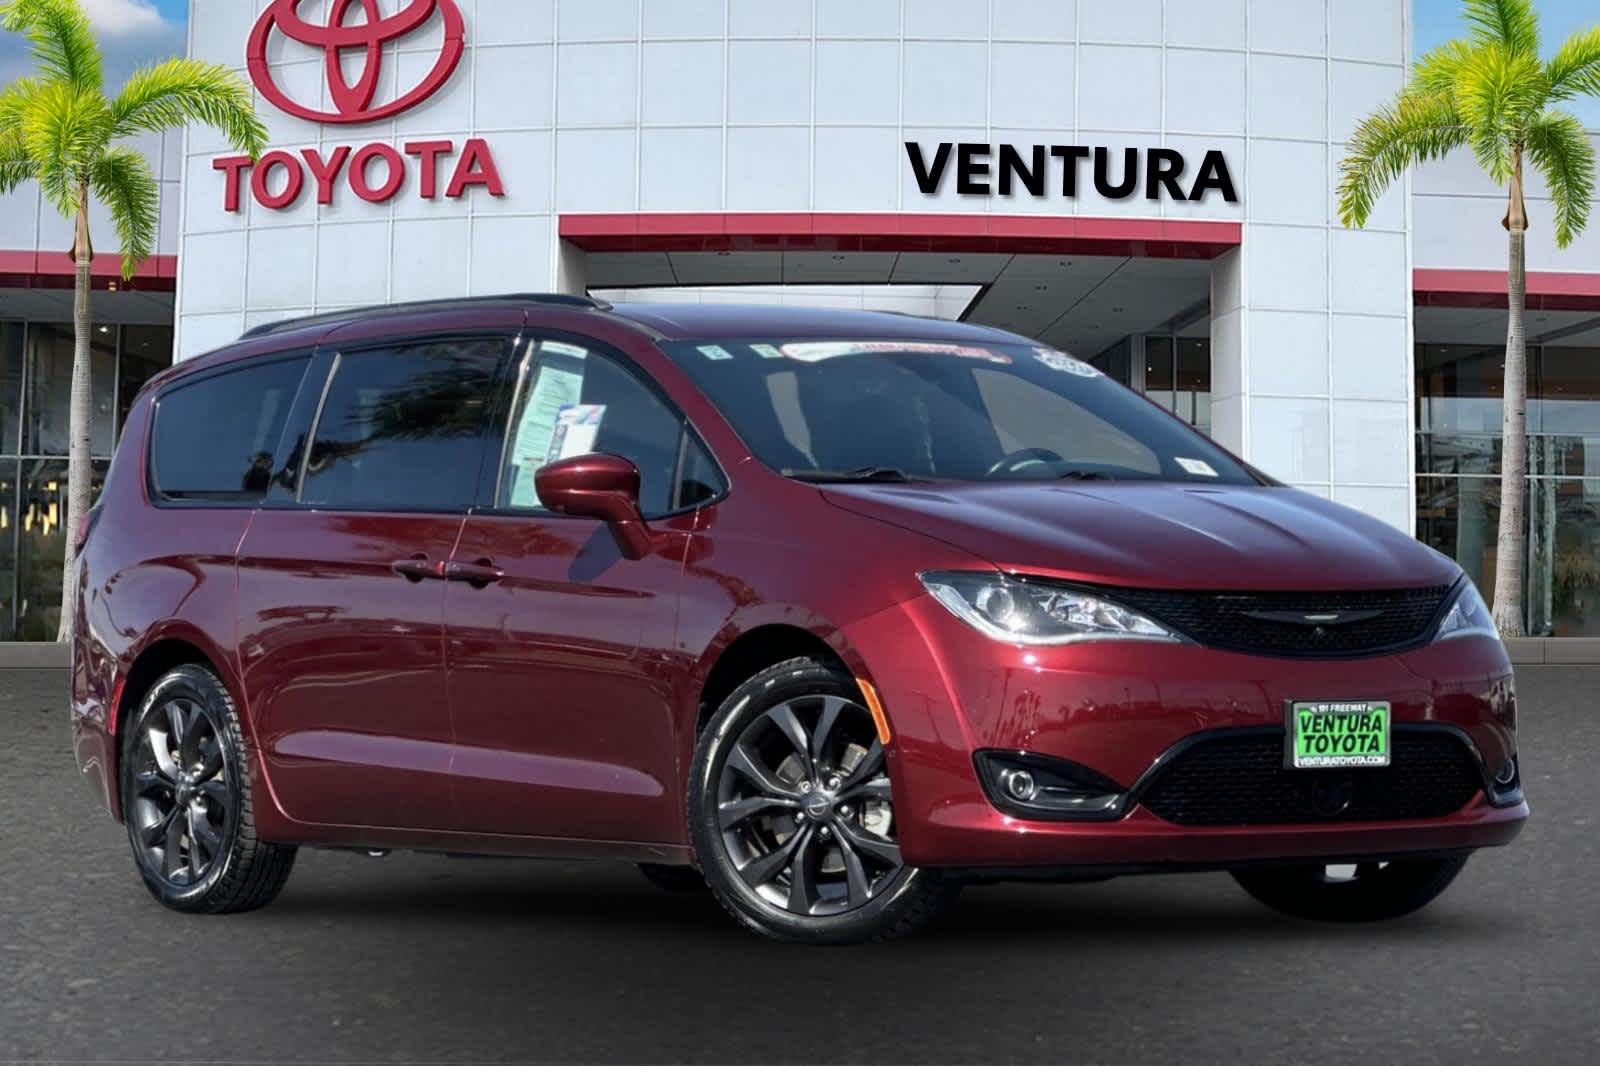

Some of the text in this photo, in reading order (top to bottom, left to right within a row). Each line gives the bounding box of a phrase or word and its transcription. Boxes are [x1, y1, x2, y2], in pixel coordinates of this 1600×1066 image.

[212, 138, 505, 212] TOYOTA
[904, 142, 1239, 203] VENTURA
[1300, 715, 1382, 733] VENTURA
[1303, 734, 1380, 753] TOYOTA
